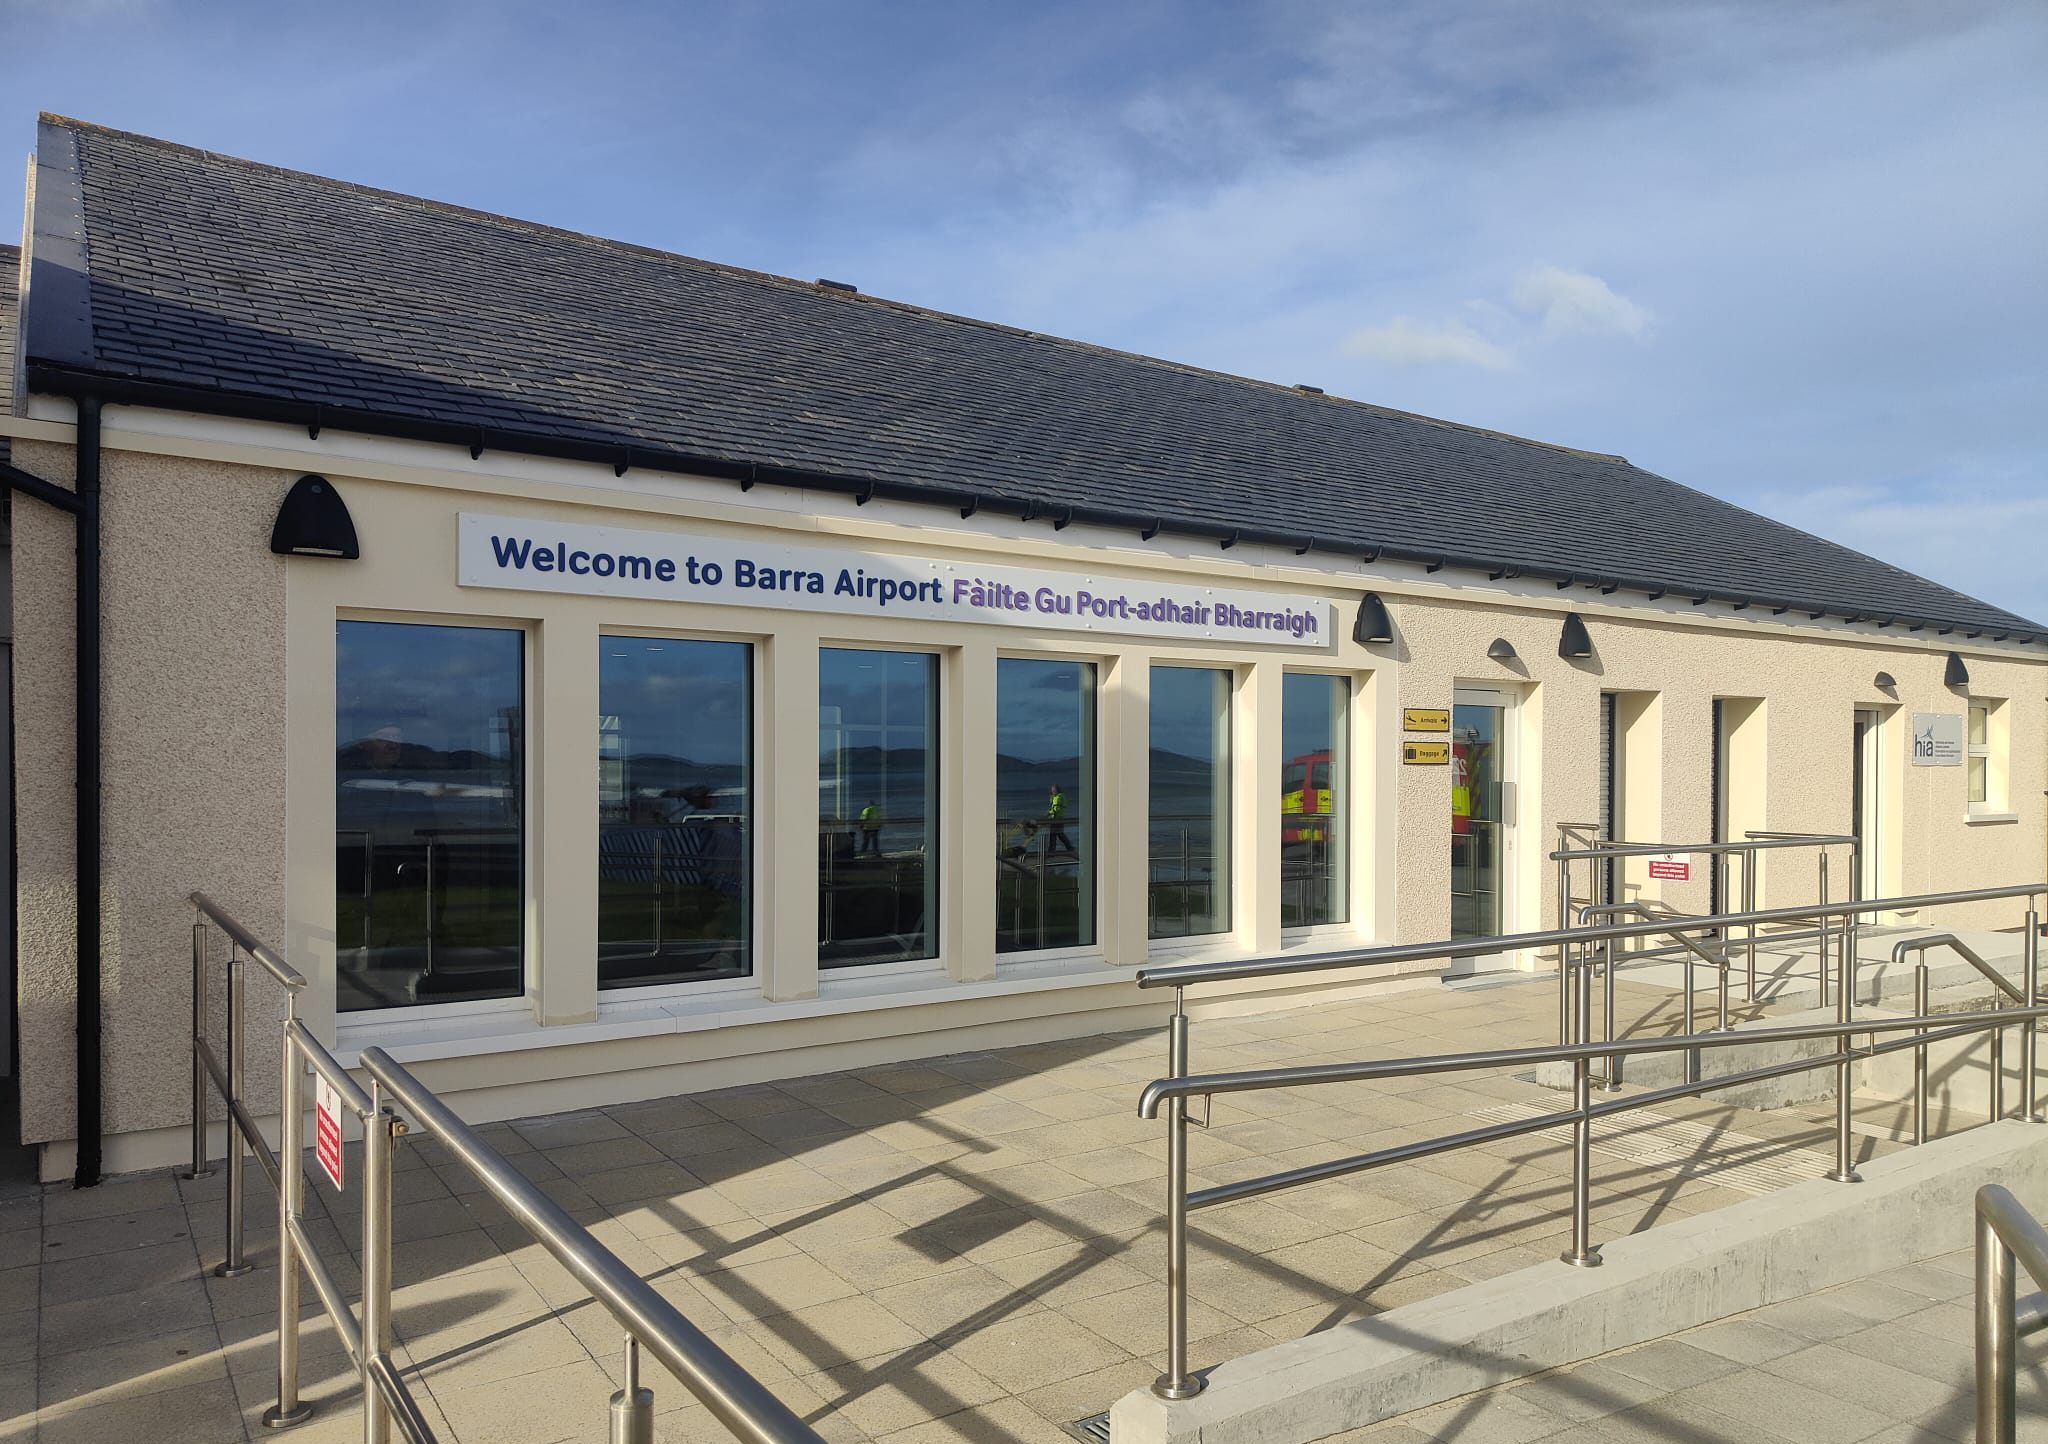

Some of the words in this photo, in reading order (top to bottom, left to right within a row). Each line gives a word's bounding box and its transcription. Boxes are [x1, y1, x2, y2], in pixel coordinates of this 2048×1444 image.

[490, 535, 676, 584] Welcome
[686, 555, 723, 586] to
[734, 559, 825, 594] Barra
[834, 568, 944, 607] Airport
[953, 578, 1031, 612] Fàilte
[1035, 587, 1071, 615] Gu
[1077, 591, 1212, 626] Port-adhair
[1214, 603, 1318, 639] Bharraigh
[1914, 733, 1933, 757] hia
